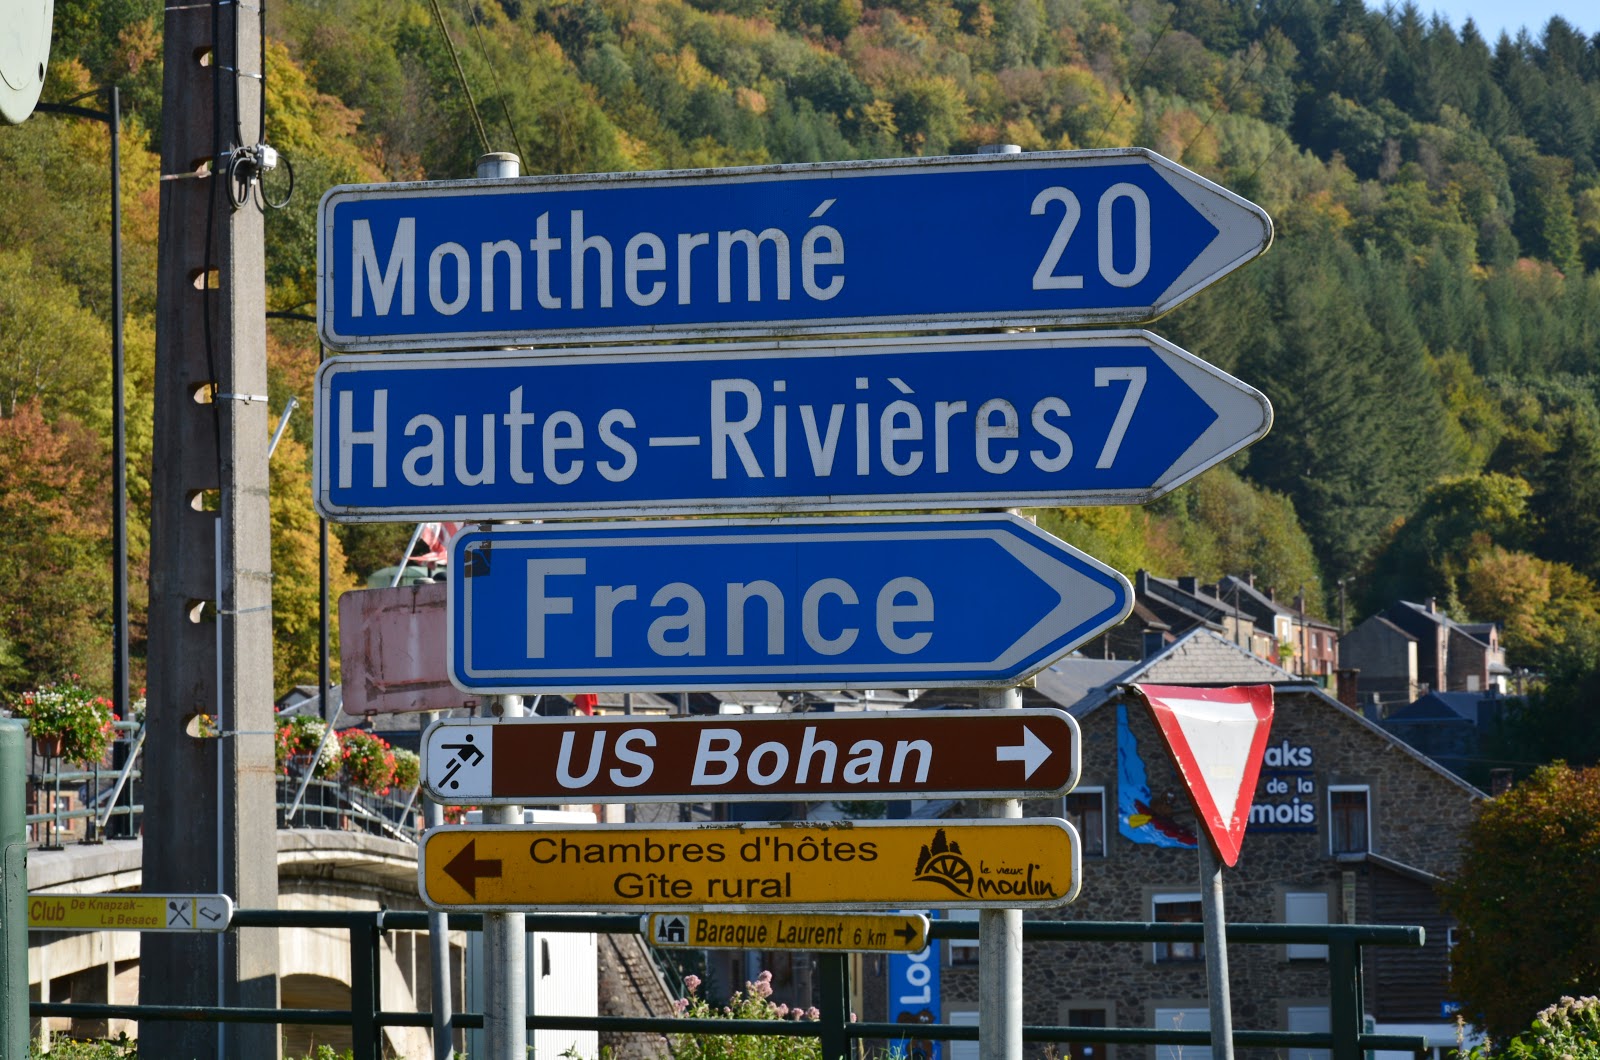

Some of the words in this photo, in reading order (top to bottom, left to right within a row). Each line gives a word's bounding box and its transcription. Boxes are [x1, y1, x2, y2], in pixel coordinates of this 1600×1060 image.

[351, 198, 845, 318] Monthermé
[1029, 182, 1151, 290] 20
[1094, 366, 1148, 469] 7
[526, 557, 935, 659] France
[554, 728, 657, 789] US
[690, 725, 934, 787] Bohan
[1264, 740, 1312, 767] aks
[1266, 778, 1288, 794] de
[1298, 777, 1313, 793] la
[1249, 797, 1314, 823] mois
[529, 838, 724, 867] Chambres
[739, 835, 878, 864] d'hôtes
[977, 863, 1058, 898] moulin
[980, 860, 991, 874] le
[996, 861, 1023, 875] vieux
[614, 871, 694, 898] Gîte
[707, 871, 792, 898] rural
[30, 901, 65, 921] Club
[71, 899, 86, 910] De
[101, 914, 114, 925] La
[117, 914, 158, 926] Besace
[696, 918, 767, 948] Baraque
[776, 920, 843, 945] Laurent
[853, 928, 862, 946] 6
[867, 928, 887, 946] km
